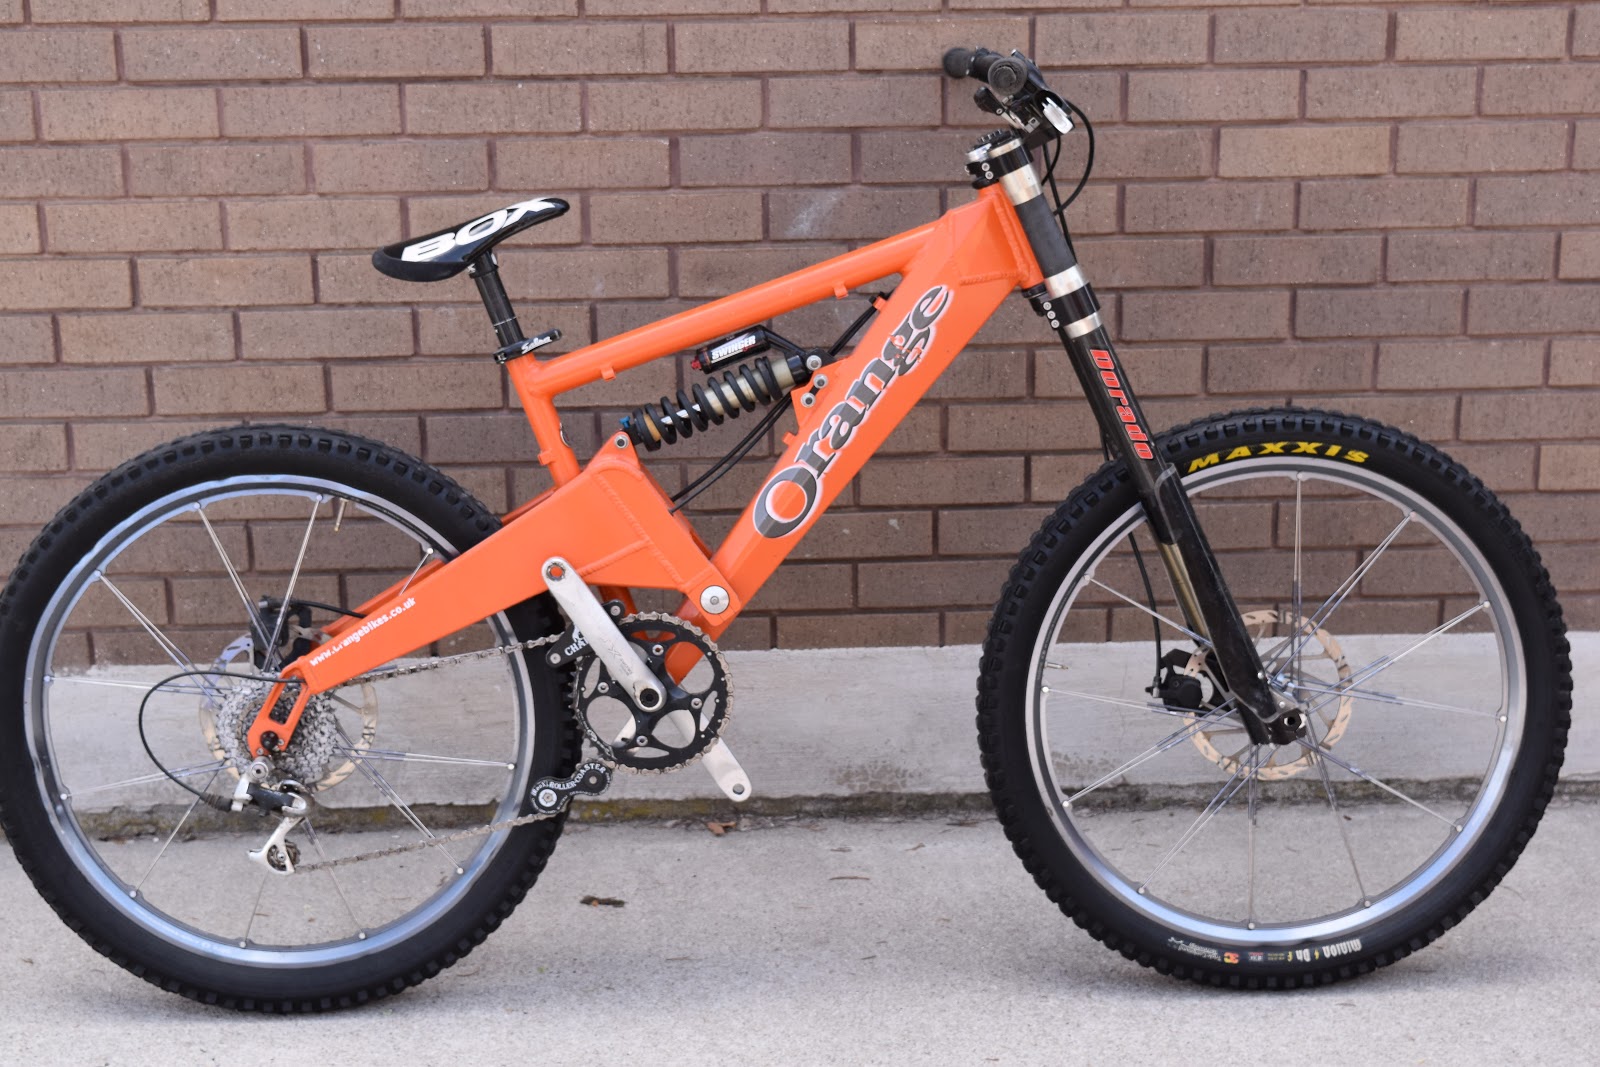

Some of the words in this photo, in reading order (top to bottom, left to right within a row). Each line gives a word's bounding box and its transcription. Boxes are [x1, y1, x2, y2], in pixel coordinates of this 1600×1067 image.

[401, 197, 556, 262] BOX
[712, 335, 756, 360] SWINGER
[752, 283, 955, 539] Orange
[1188, 441, 1369, 473] MAXXIS
